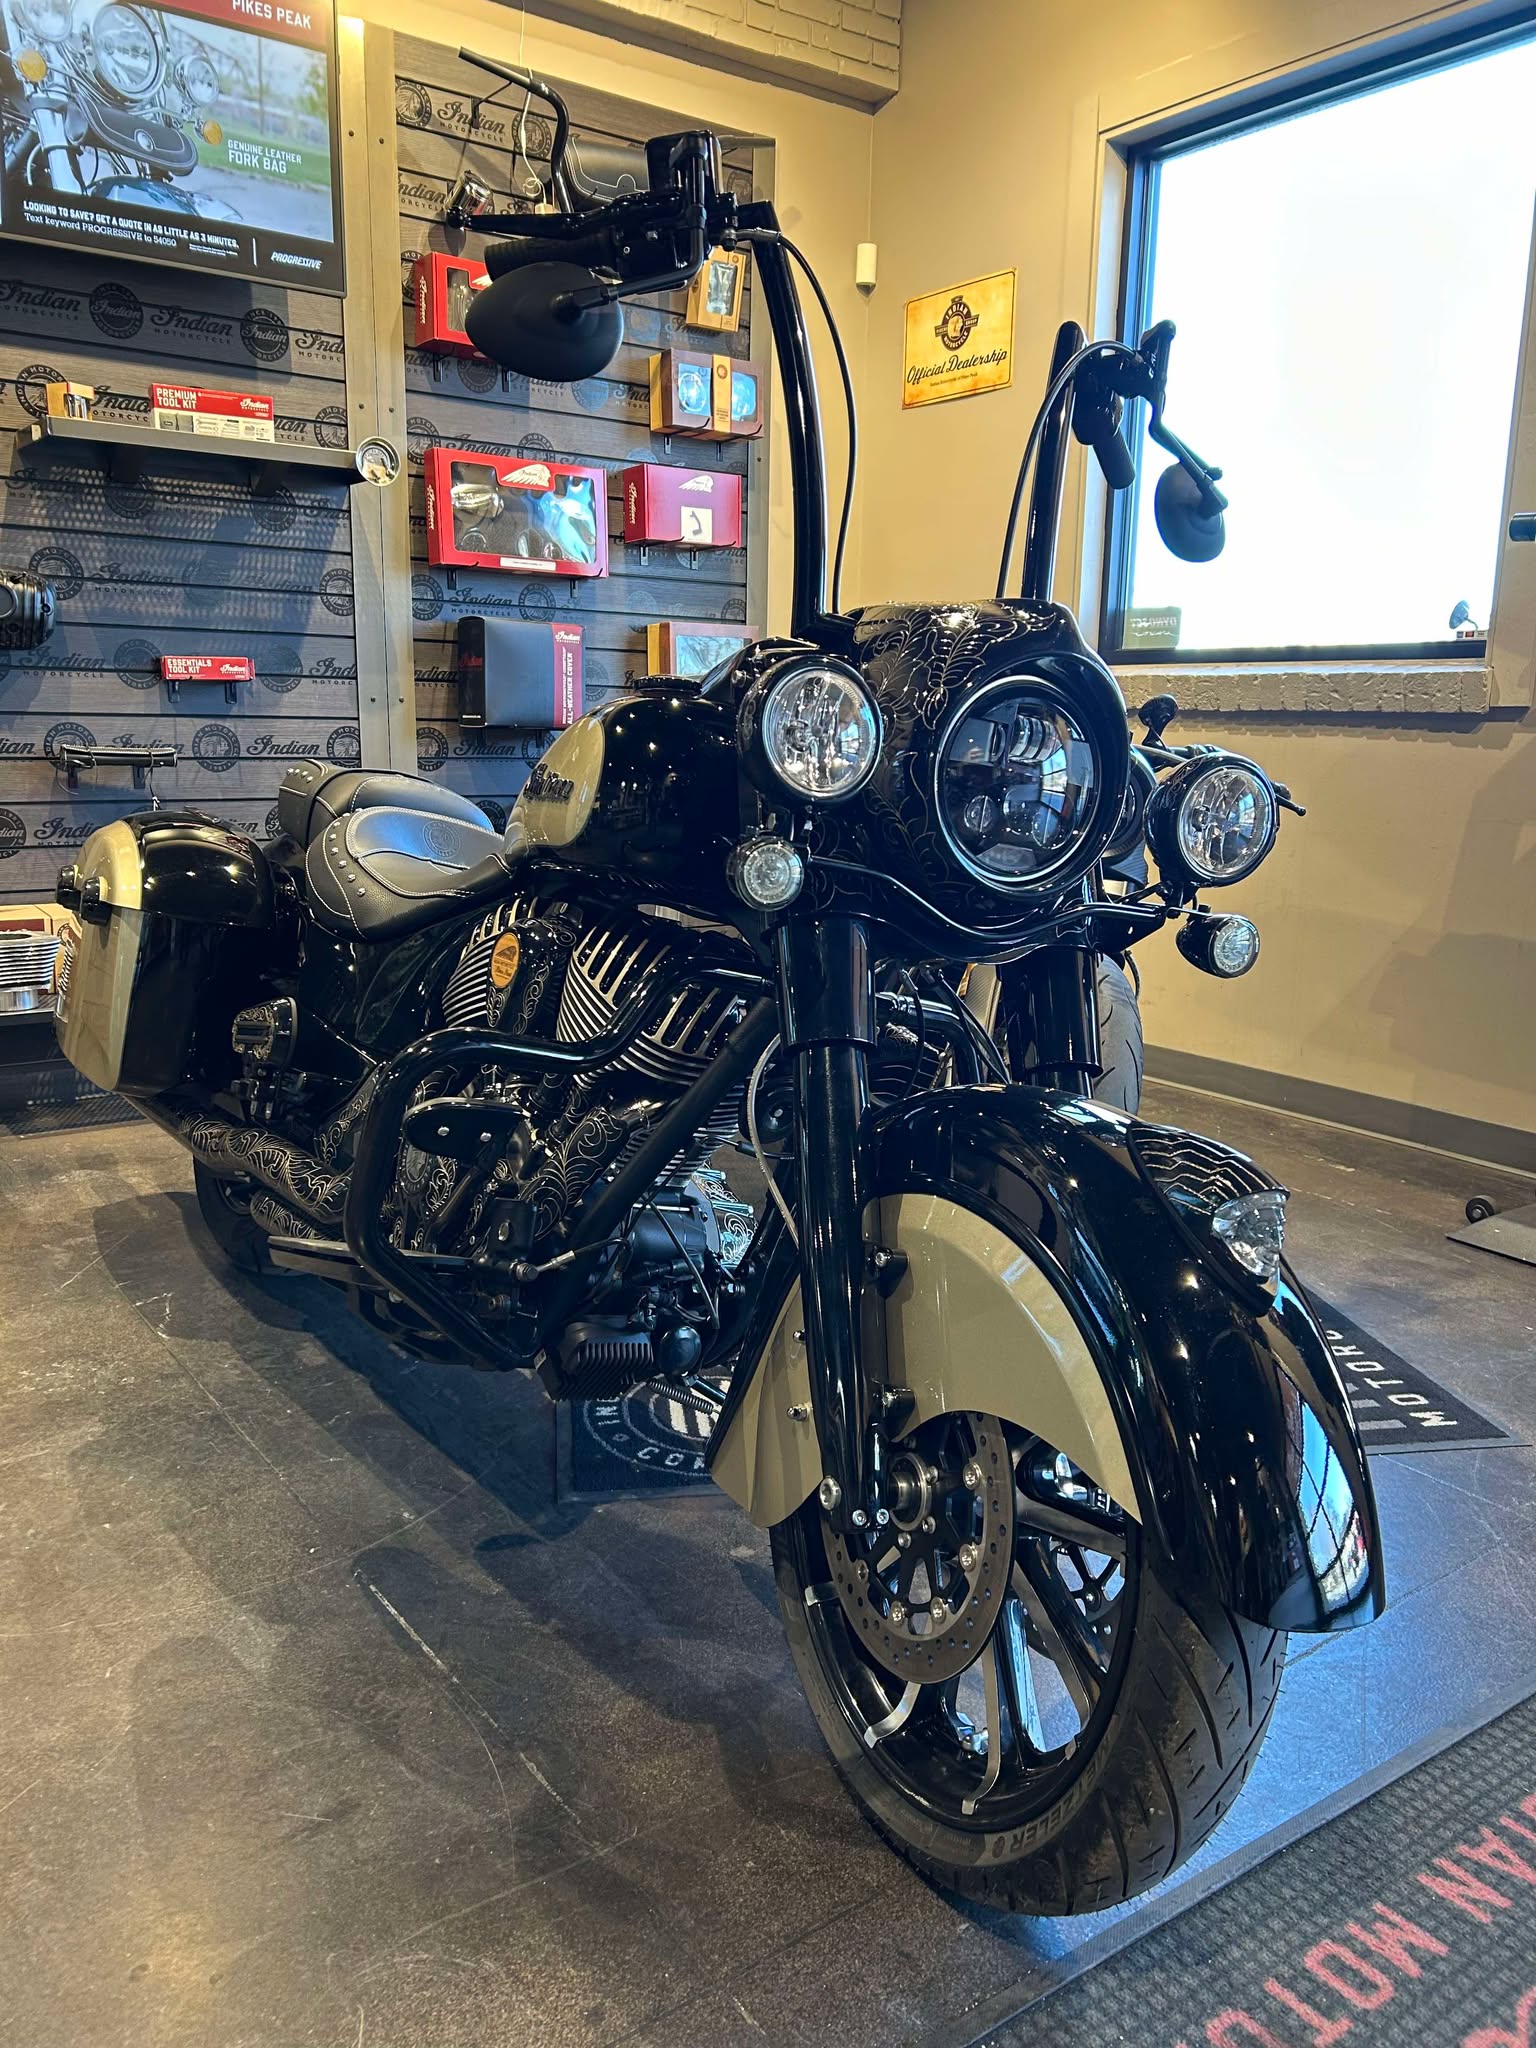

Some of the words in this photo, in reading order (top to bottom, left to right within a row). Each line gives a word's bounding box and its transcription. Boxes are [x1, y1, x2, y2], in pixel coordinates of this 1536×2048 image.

[232, 0, 272, 19] PIKES
[276, 8, 312, 30] PEAK
[437, 100, 505, 134] Inian
[228, 139, 263, 156] GENUINE
[265, 147, 302, 164] LEATHER
[228, 150, 260, 169] FORK
[263, 158, 287, 174] BAG
[399, 173, 446, 204] ndian
[23, 200, 57, 215] LOOKING
[58, 206, 68, 217] TO
[69, 208, 94, 222] SAVE?
[96, 214, 110, 225] GET
[112, 216, 118, 226] A
[119, 217, 143, 230] QUOTE
[144, 222, 152, 232] IN
[152, 223, 162, 233] AS
[164, 225, 189, 239] LITTLE
[189, 230, 200, 241] AS
[200, 232, 207, 243] 3
[207, 233, 240, 249] MINUTES.
[24, 212, 43, 223] Text
[44, 216, 81, 231] keyword
[82, 222, 143, 241] PROGRESSIVE
[144, 234, 152, 242] to
[270, 251, 323, 270] PROGRESSIVE
[4, 304, 79, 321] OTORCYCLE
[945, 302, 969, 320] INDIAN
[151, 305, 233, 337] Indian
[241, 323, 287, 343] Indian
[906, 361, 946, 386] Official
[945, 348, 1008, 373] Dealership
[156, 387, 197, 400] PREMIUM
[158, 397, 181, 408] TOOL
[182, 399, 197, 409] KIT
[239, 397, 270, 410] Indian
[451, 607, 511, 617] MOTORCYCLE
[555, 630, 580, 641] Indian
[167, 658, 212, 667] ESSENTIALS
[168, 665, 187, 674] TOOL
[188, 665, 200, 674] KIT
[23, 670, 104, 678] MOTORCYCLE
[312, 679, 353, 687] MOTORC
[246, 734, 321, 756] Indian
[453, 737, 516, 756] Indian
[1326, 1329, 1458, 1427] MOTORC
